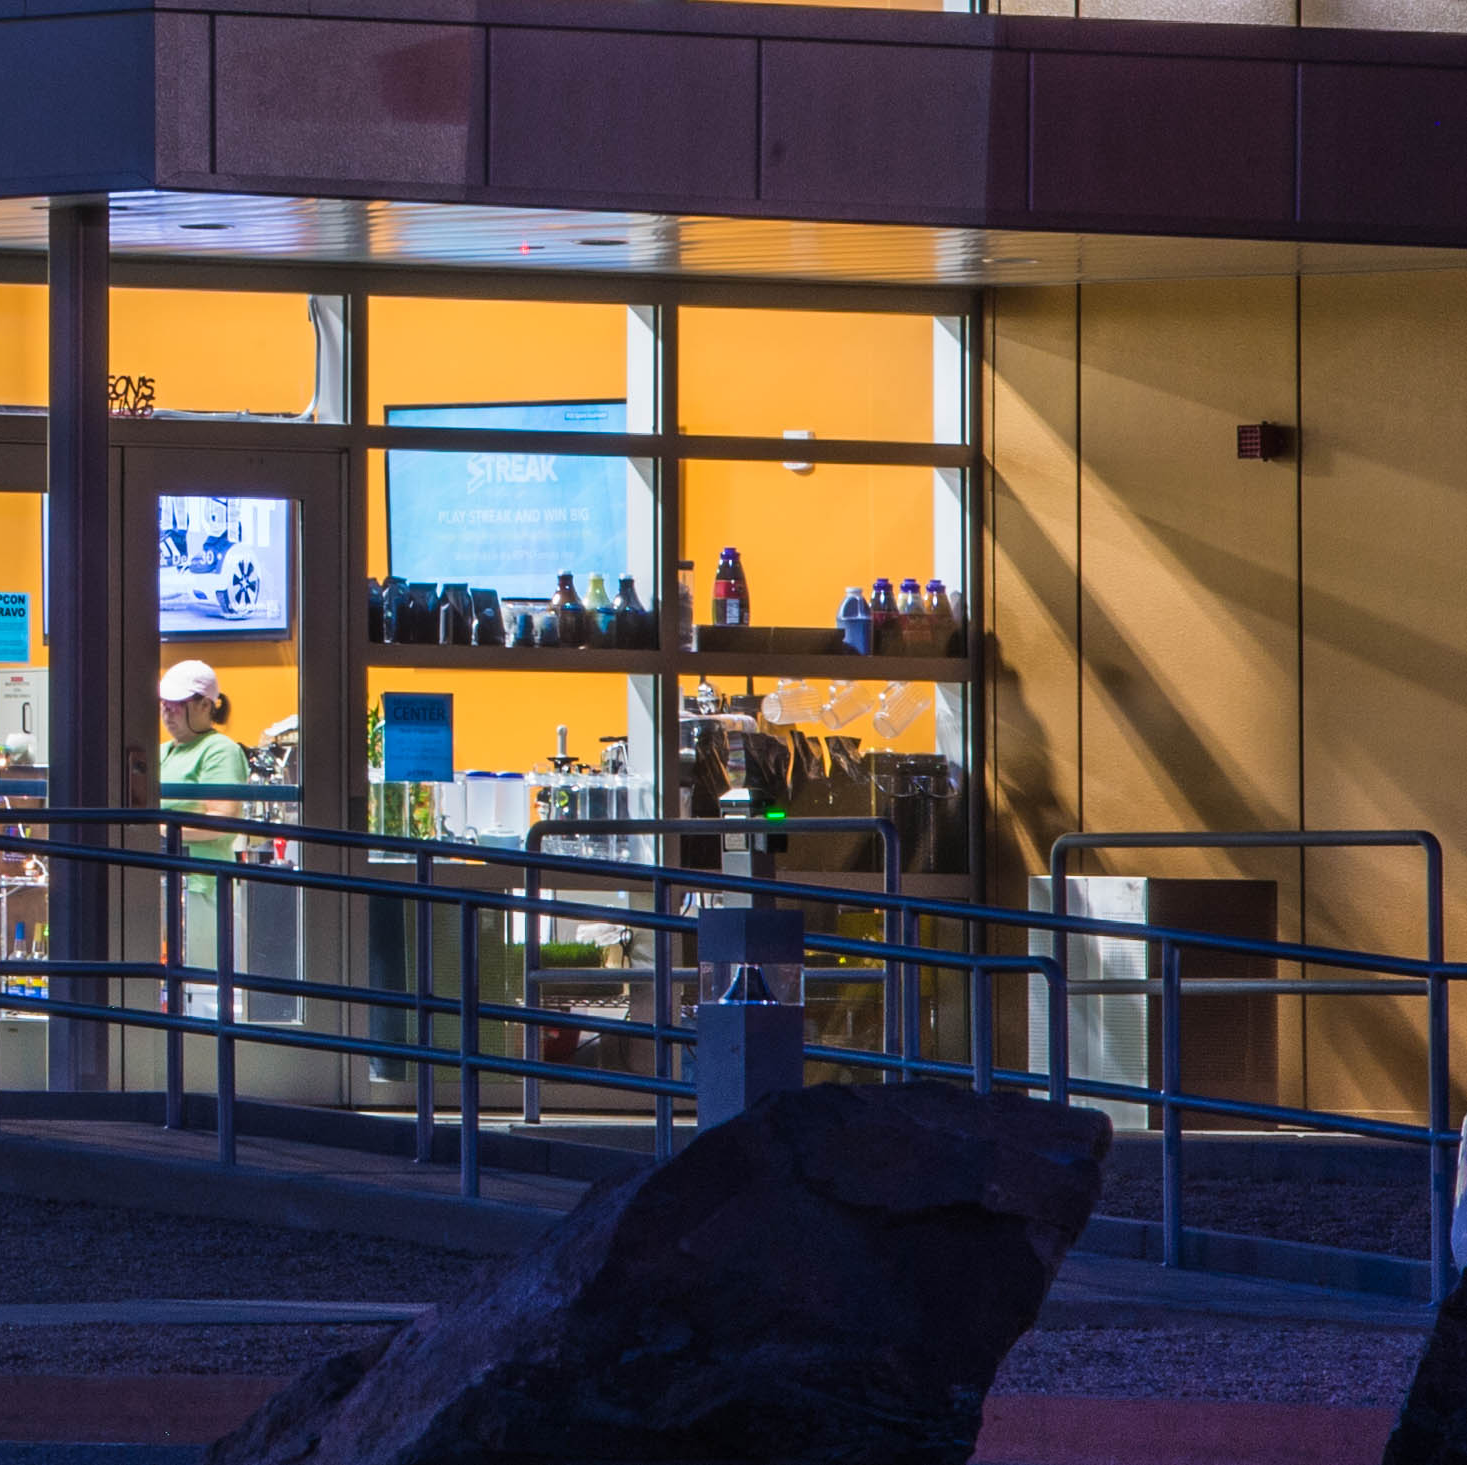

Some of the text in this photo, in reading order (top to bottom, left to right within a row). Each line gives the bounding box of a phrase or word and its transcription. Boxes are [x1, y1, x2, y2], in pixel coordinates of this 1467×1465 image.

[438, 507, 591, 524] PLAY STREAK AND WIN BIG
[393, 706, 445, 721] CENTER
